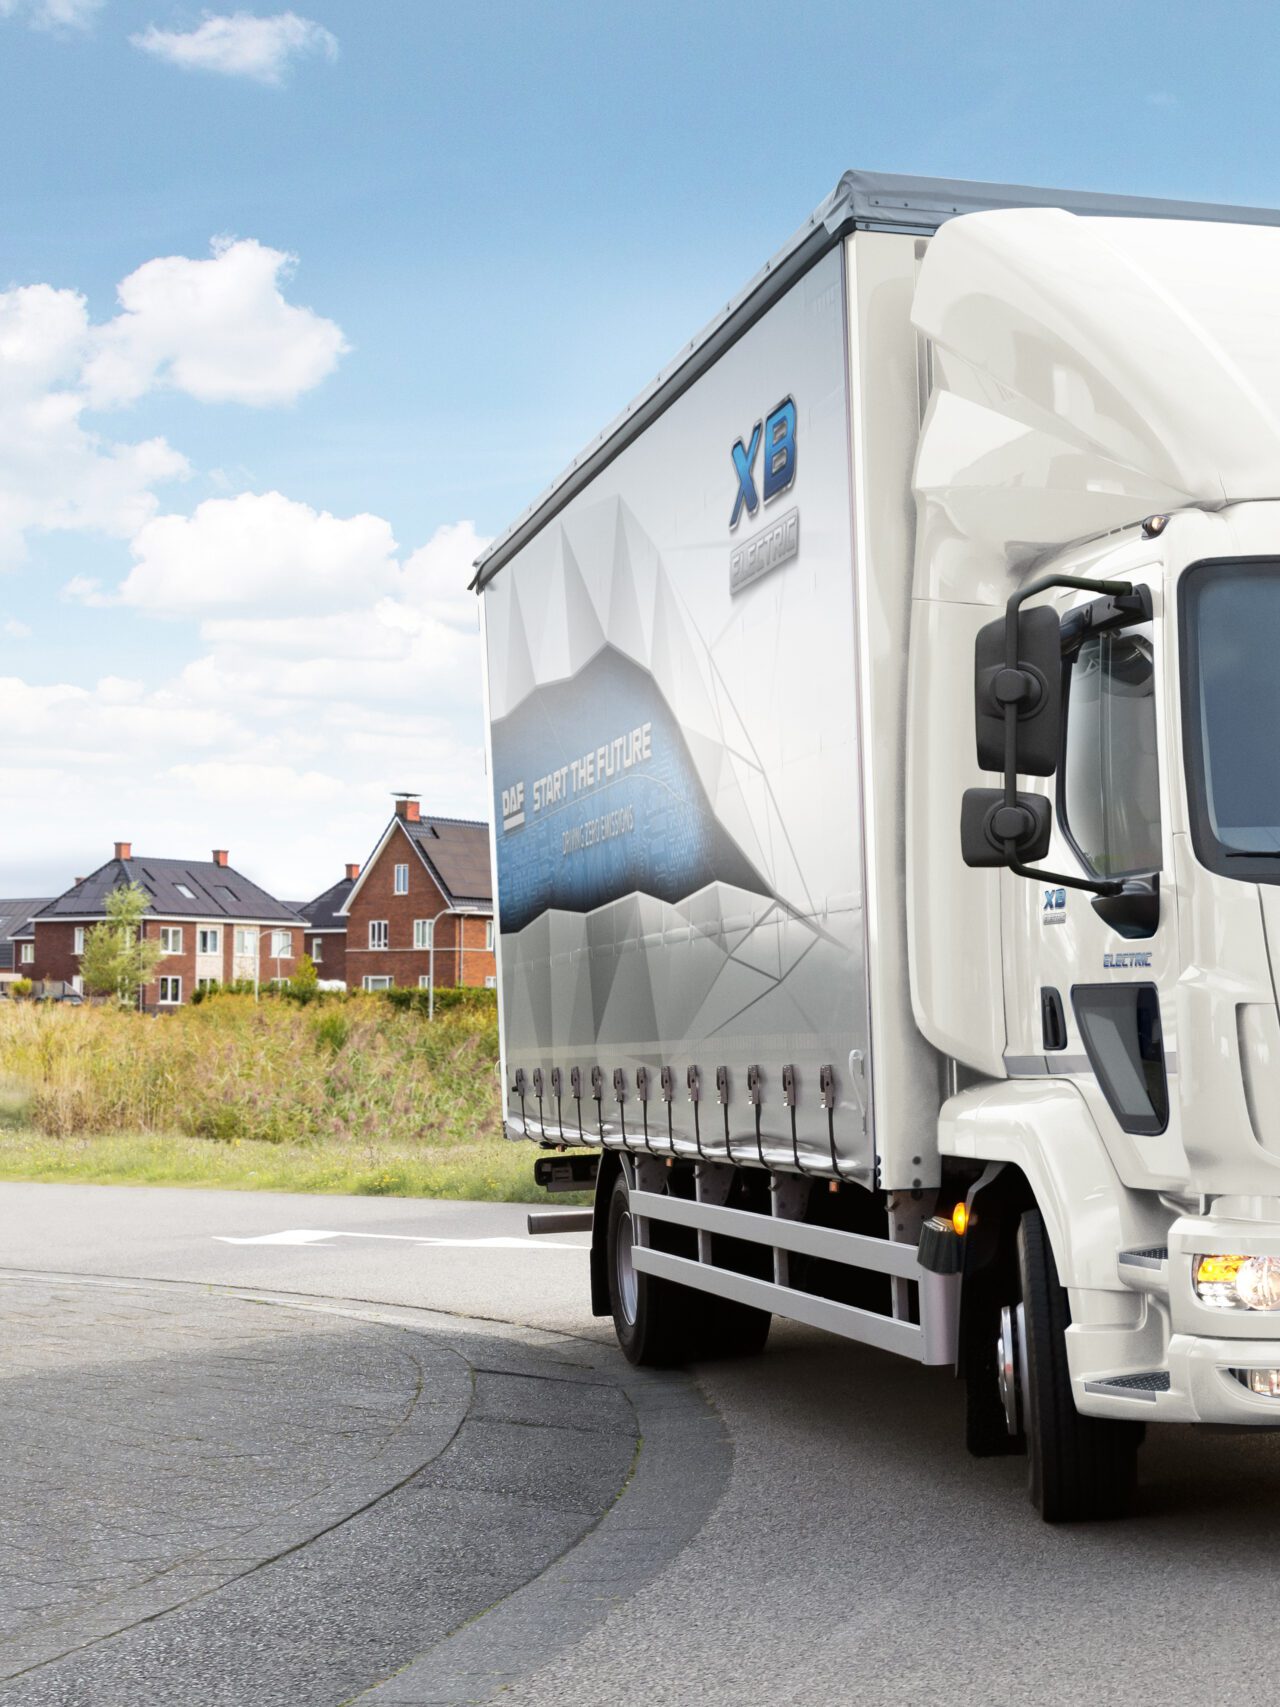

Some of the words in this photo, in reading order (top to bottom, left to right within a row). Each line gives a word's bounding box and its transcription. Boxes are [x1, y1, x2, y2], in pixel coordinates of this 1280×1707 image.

[730, 393, 797, 532] XB
[733, 516, 796, 578] ELECTRIC
[502, 782, 524, 816] DAF
[533, 766, 568, 811] START
[571, 752, 595, 792] THE
[597, 722, 652, 781] FUTURE
[1043, 888, 1066, 910] XB
[1103, 952, 1152, 968] ELECTRIC
